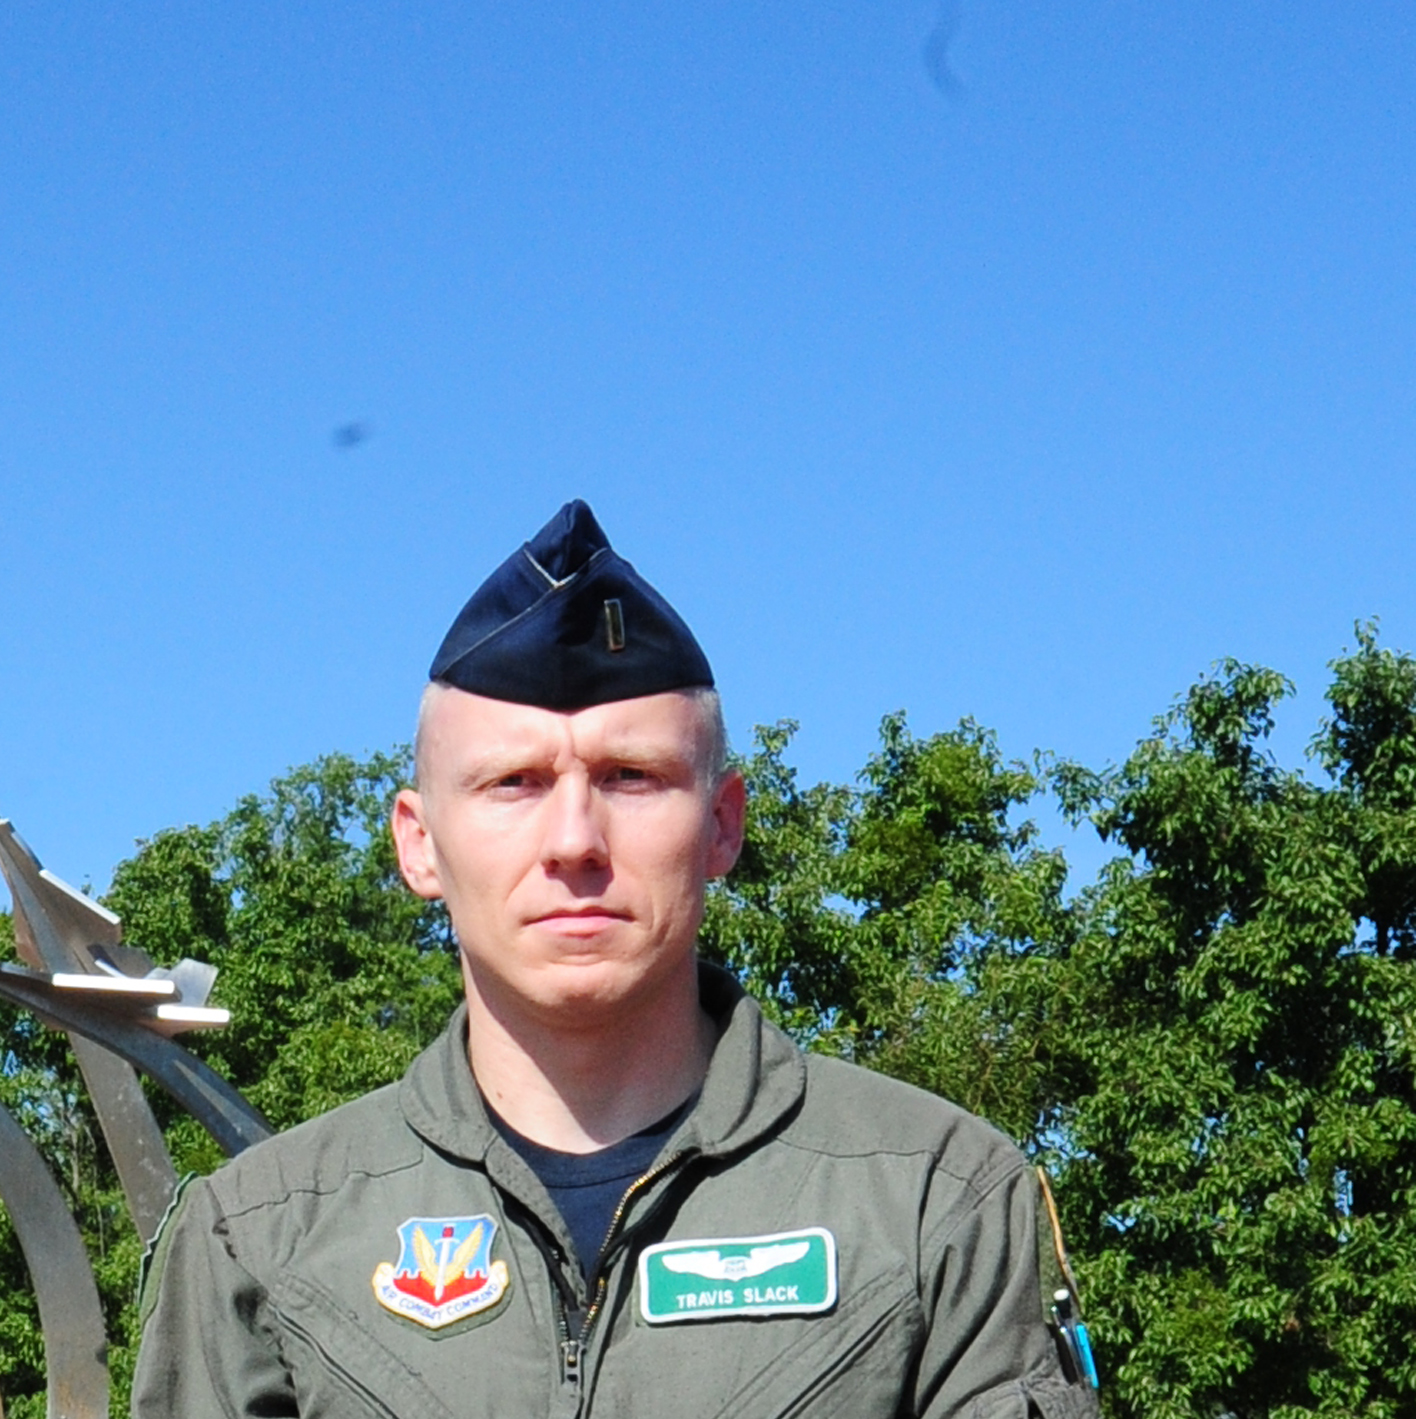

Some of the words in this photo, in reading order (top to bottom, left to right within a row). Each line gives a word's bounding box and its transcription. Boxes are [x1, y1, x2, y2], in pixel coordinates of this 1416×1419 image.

[399, 1298, 442, 1320] COMBAT
[446, 1283, 498, 1316] COMMAND
[676, 1289, 734, 1309] TRAVIS
[743, 1285, 799, 1303] SLACK
